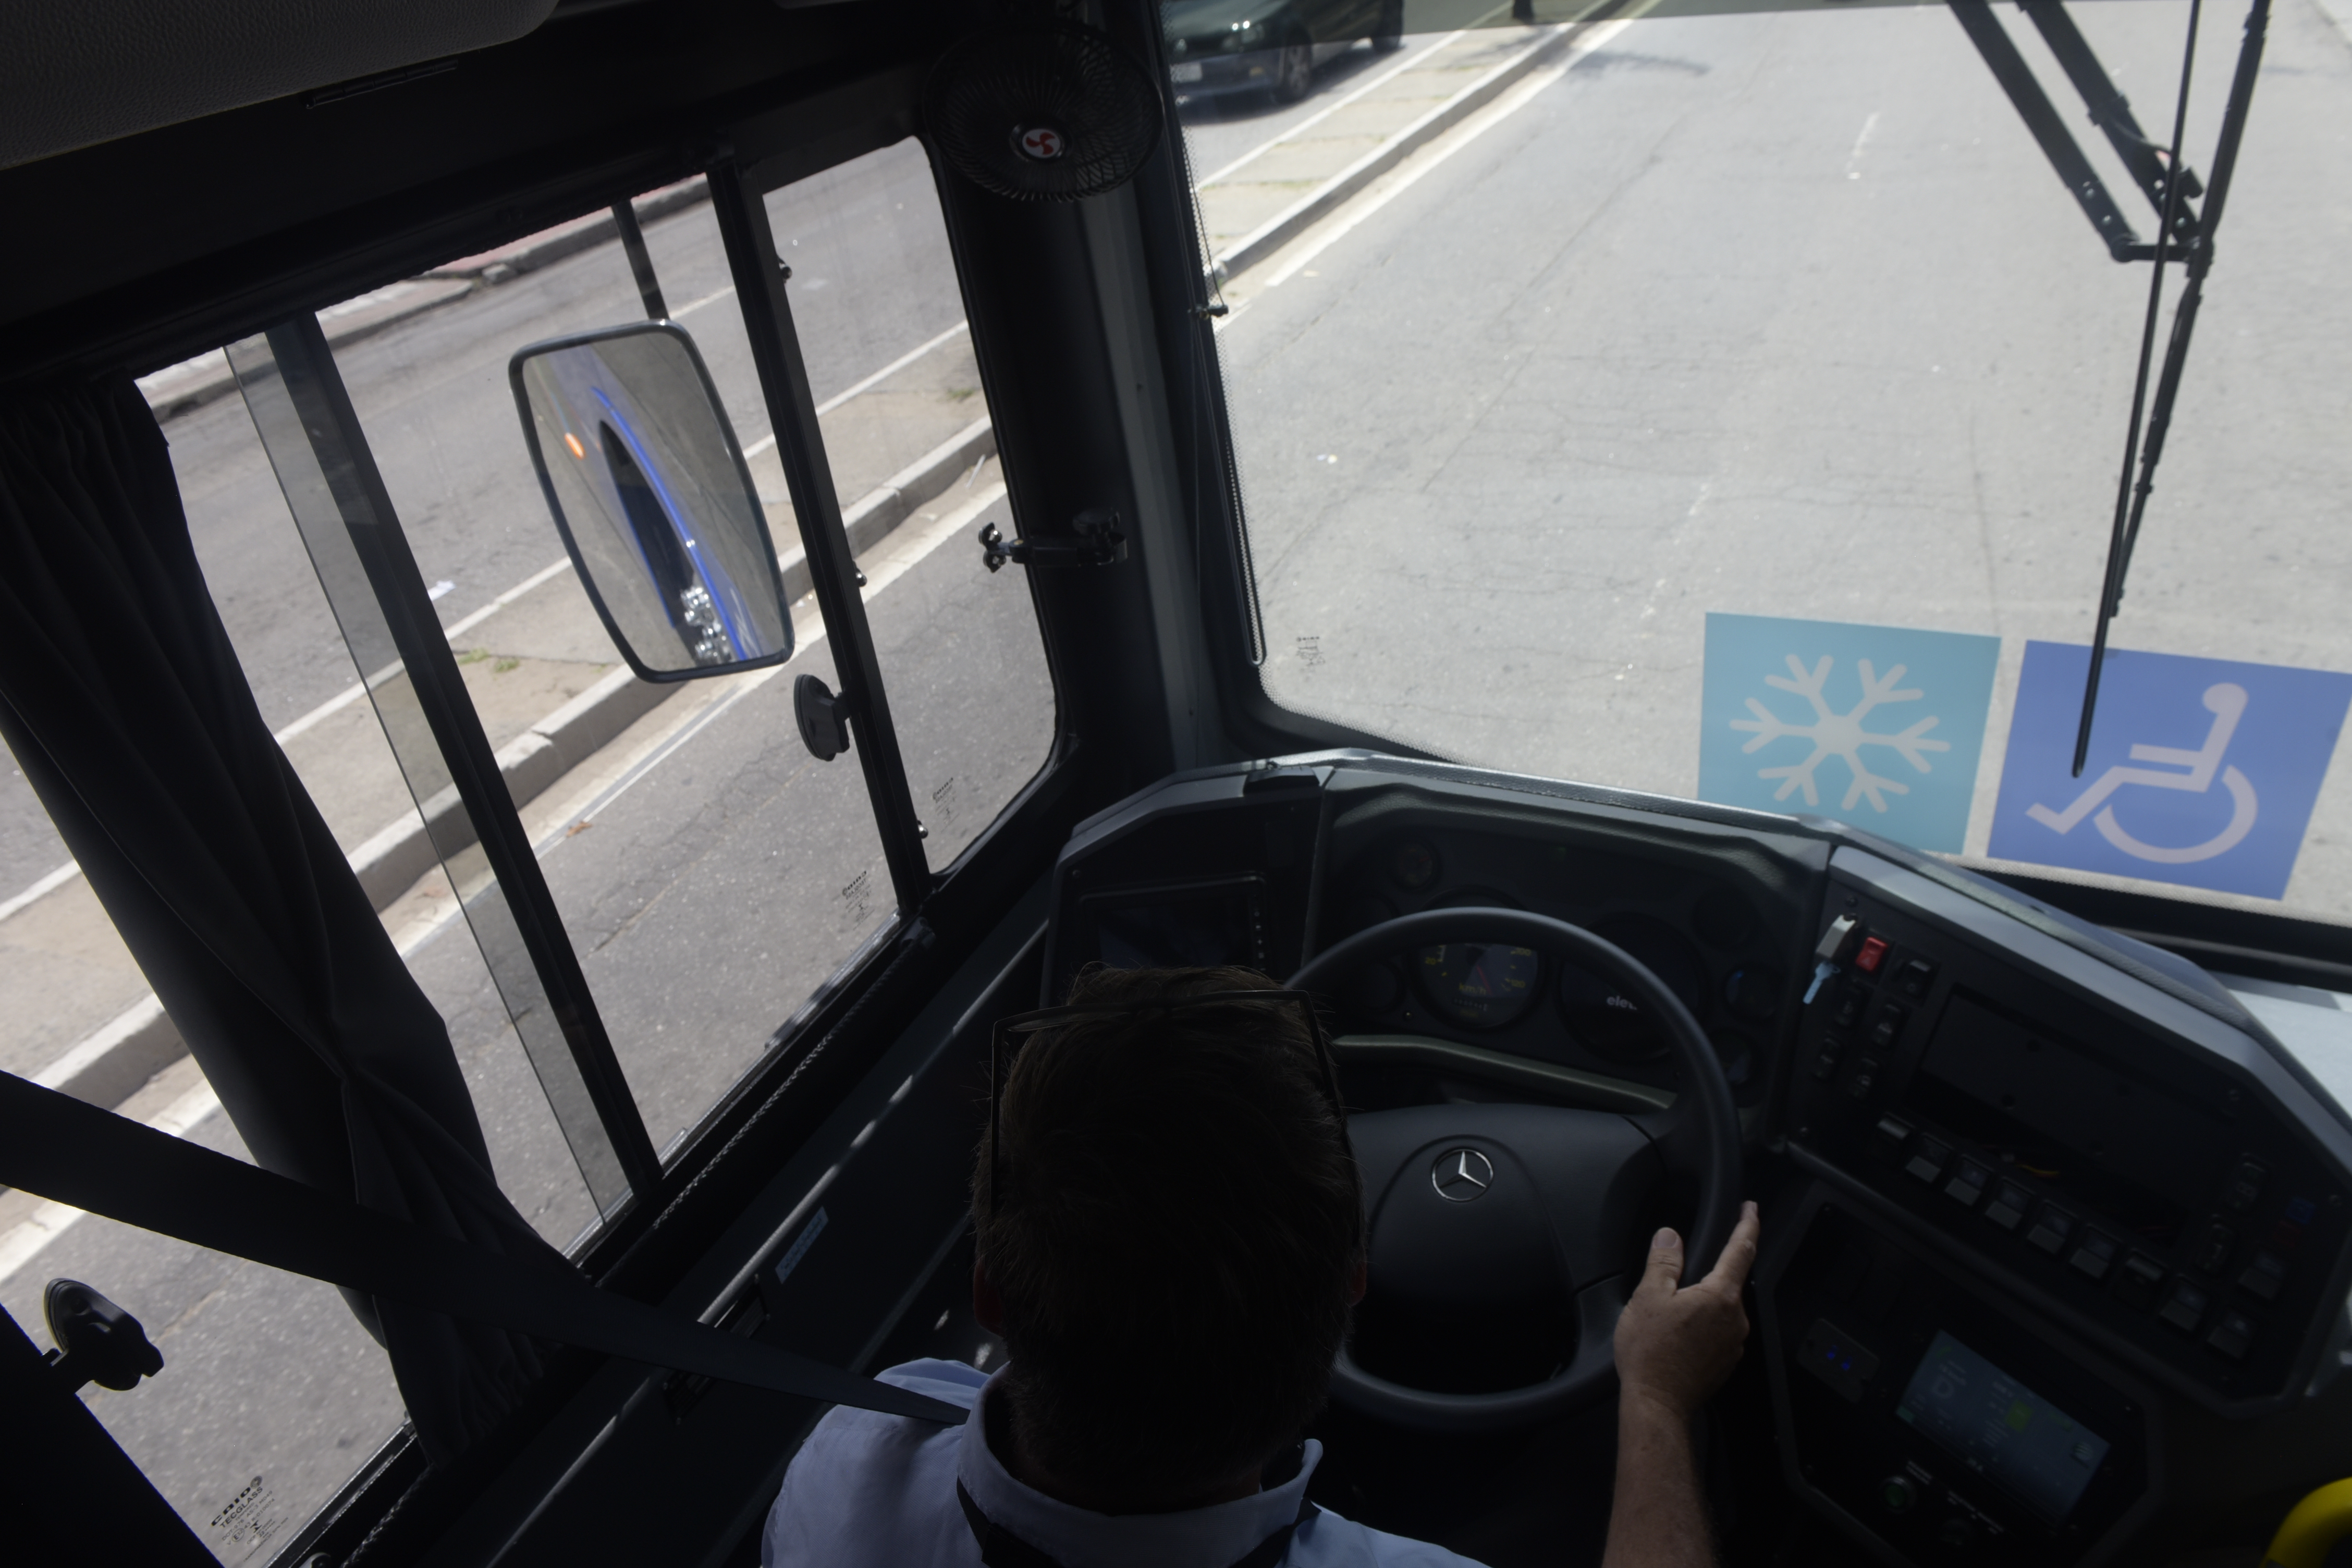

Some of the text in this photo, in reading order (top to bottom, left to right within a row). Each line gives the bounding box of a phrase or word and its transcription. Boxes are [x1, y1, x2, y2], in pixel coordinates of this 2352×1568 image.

[1458, 982, 1487, 995] km/h
[219, 1486, 263, 1528] TECGLASS
[235, 1502, 255, 1522] TEMPERED
[222, 1519, 244, 1541] DOT-976
[246, 1504, 259, 1517] AS-3
